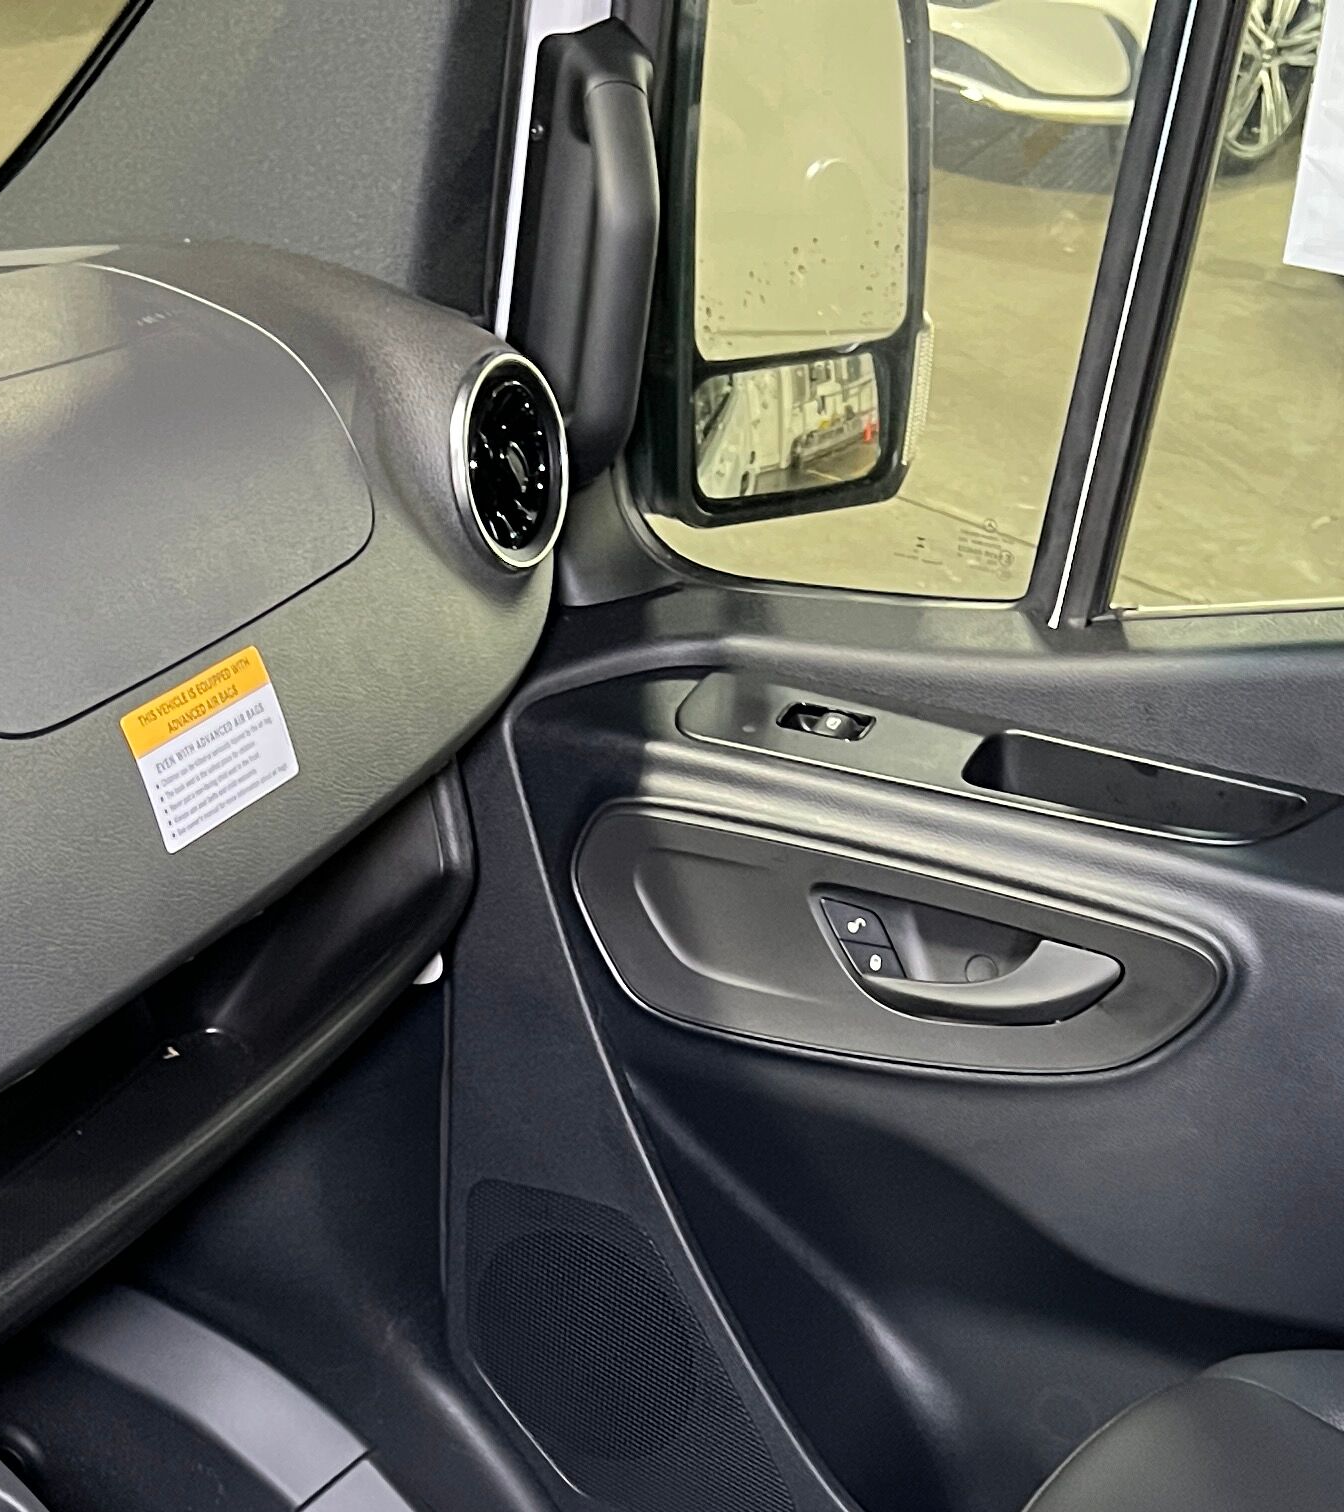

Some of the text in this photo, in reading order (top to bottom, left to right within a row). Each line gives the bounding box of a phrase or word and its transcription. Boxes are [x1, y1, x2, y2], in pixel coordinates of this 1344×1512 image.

[137, 657, 250, 728] THIS VEHICLE IS EQUIPPED WITH
[167, 684, 239, 733] ADVANCED AIR BAGS
[156, 755, 177, 774] EVEN
[176, 744, 196, 761] WITH
[196, 721, 233, 750] ADVANCED
[233, 713, 246, 727] AIR
